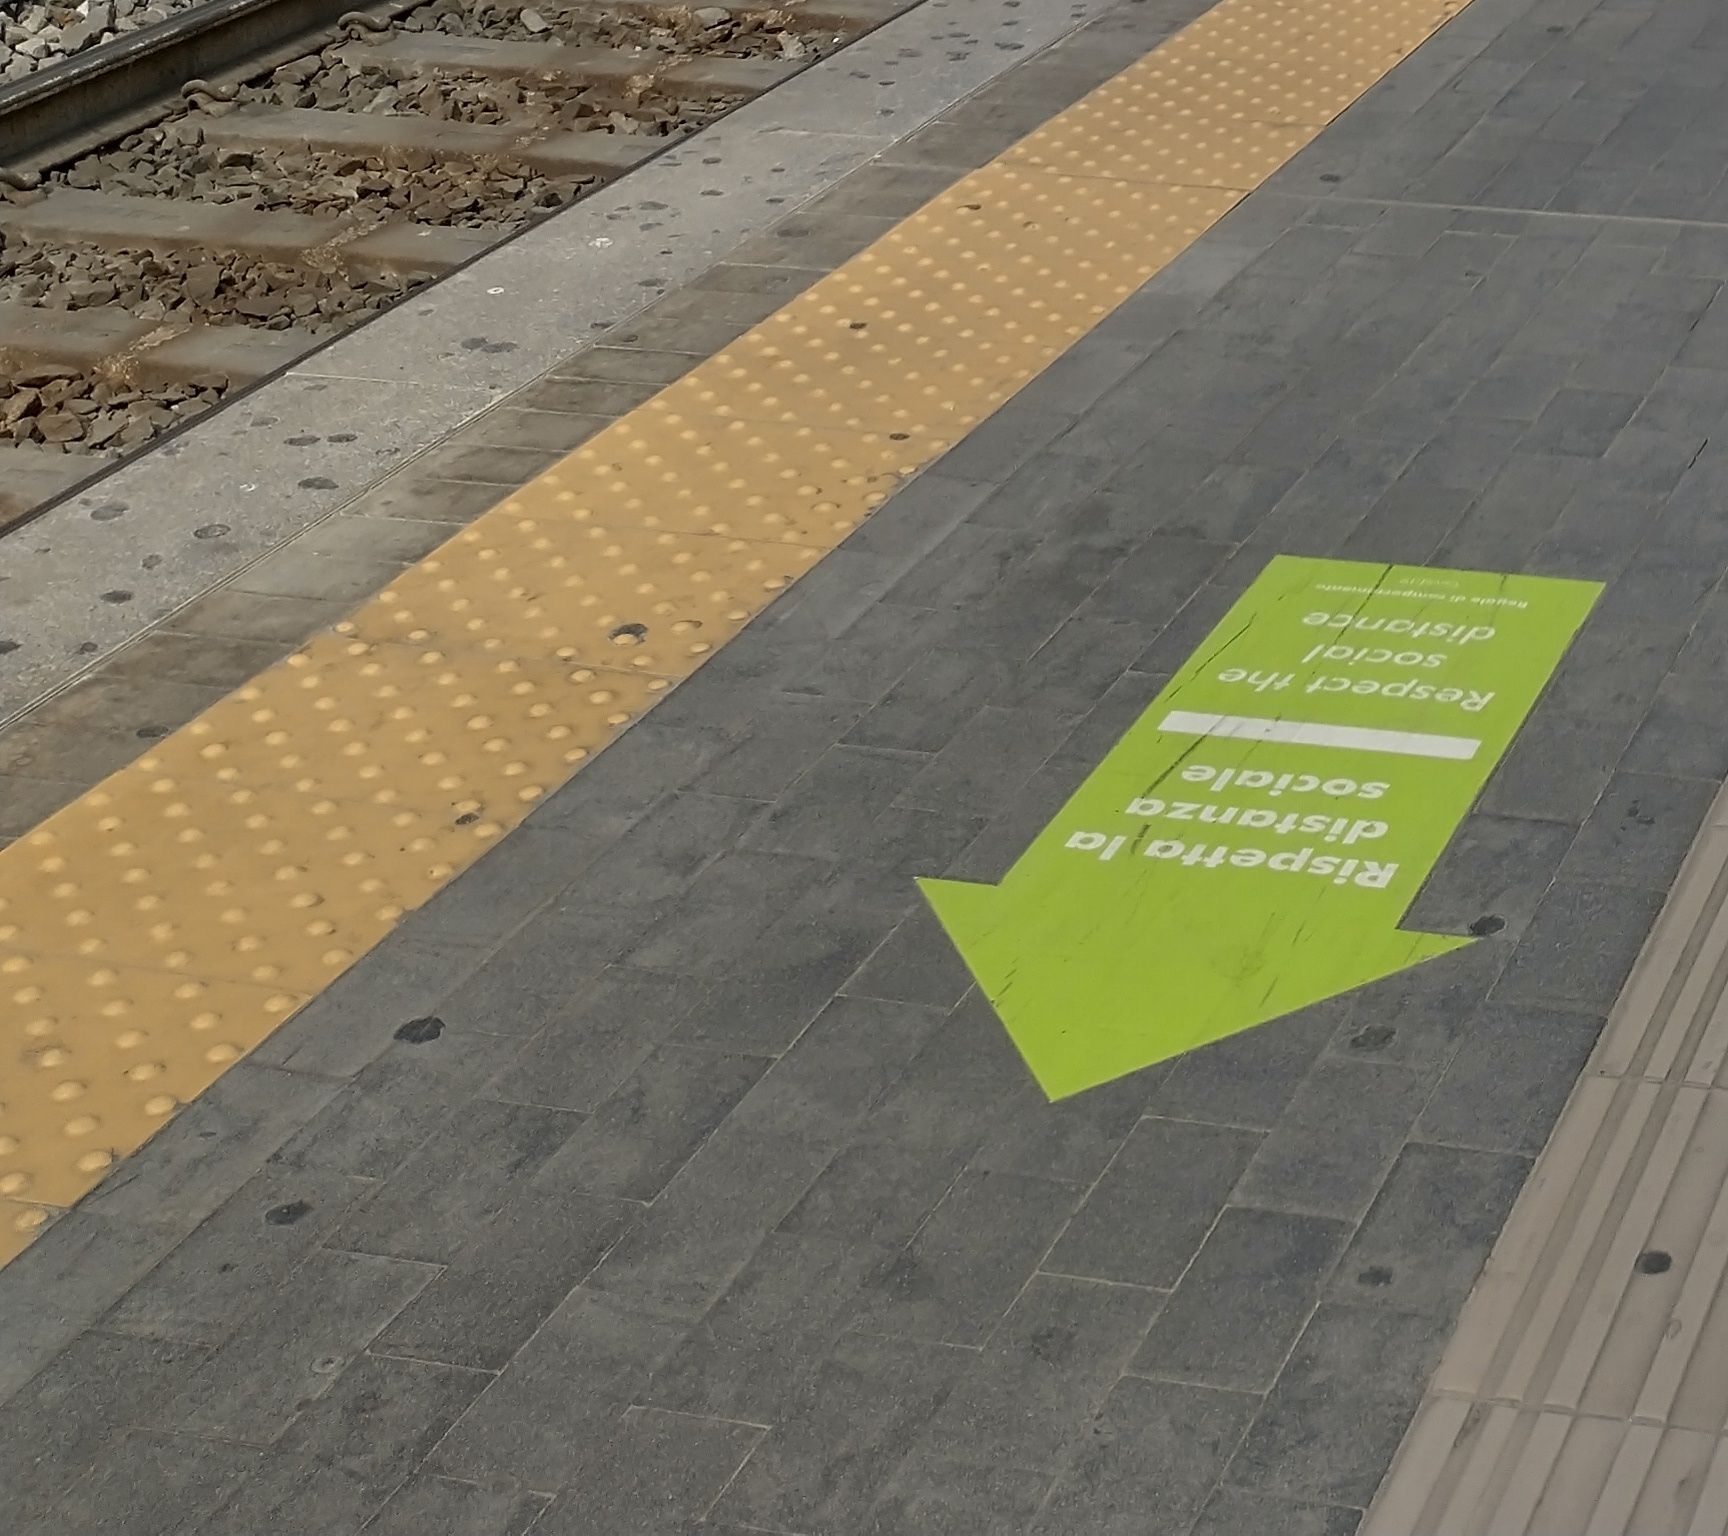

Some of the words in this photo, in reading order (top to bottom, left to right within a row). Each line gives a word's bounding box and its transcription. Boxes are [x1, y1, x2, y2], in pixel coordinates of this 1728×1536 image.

[1302, 611, 1496, 645] distance
[1301, 644, 1447, 668] social
[1218, 668, 1296, 692] the
[1306, 675, 1496, 712] Respect
[1181, 764, 1391, 799] sociale
[1124, 797, 1389, 844] distanza
[1065, 831, 1126, 860] la
[1144, 839, 1399, 889] Rispetta
